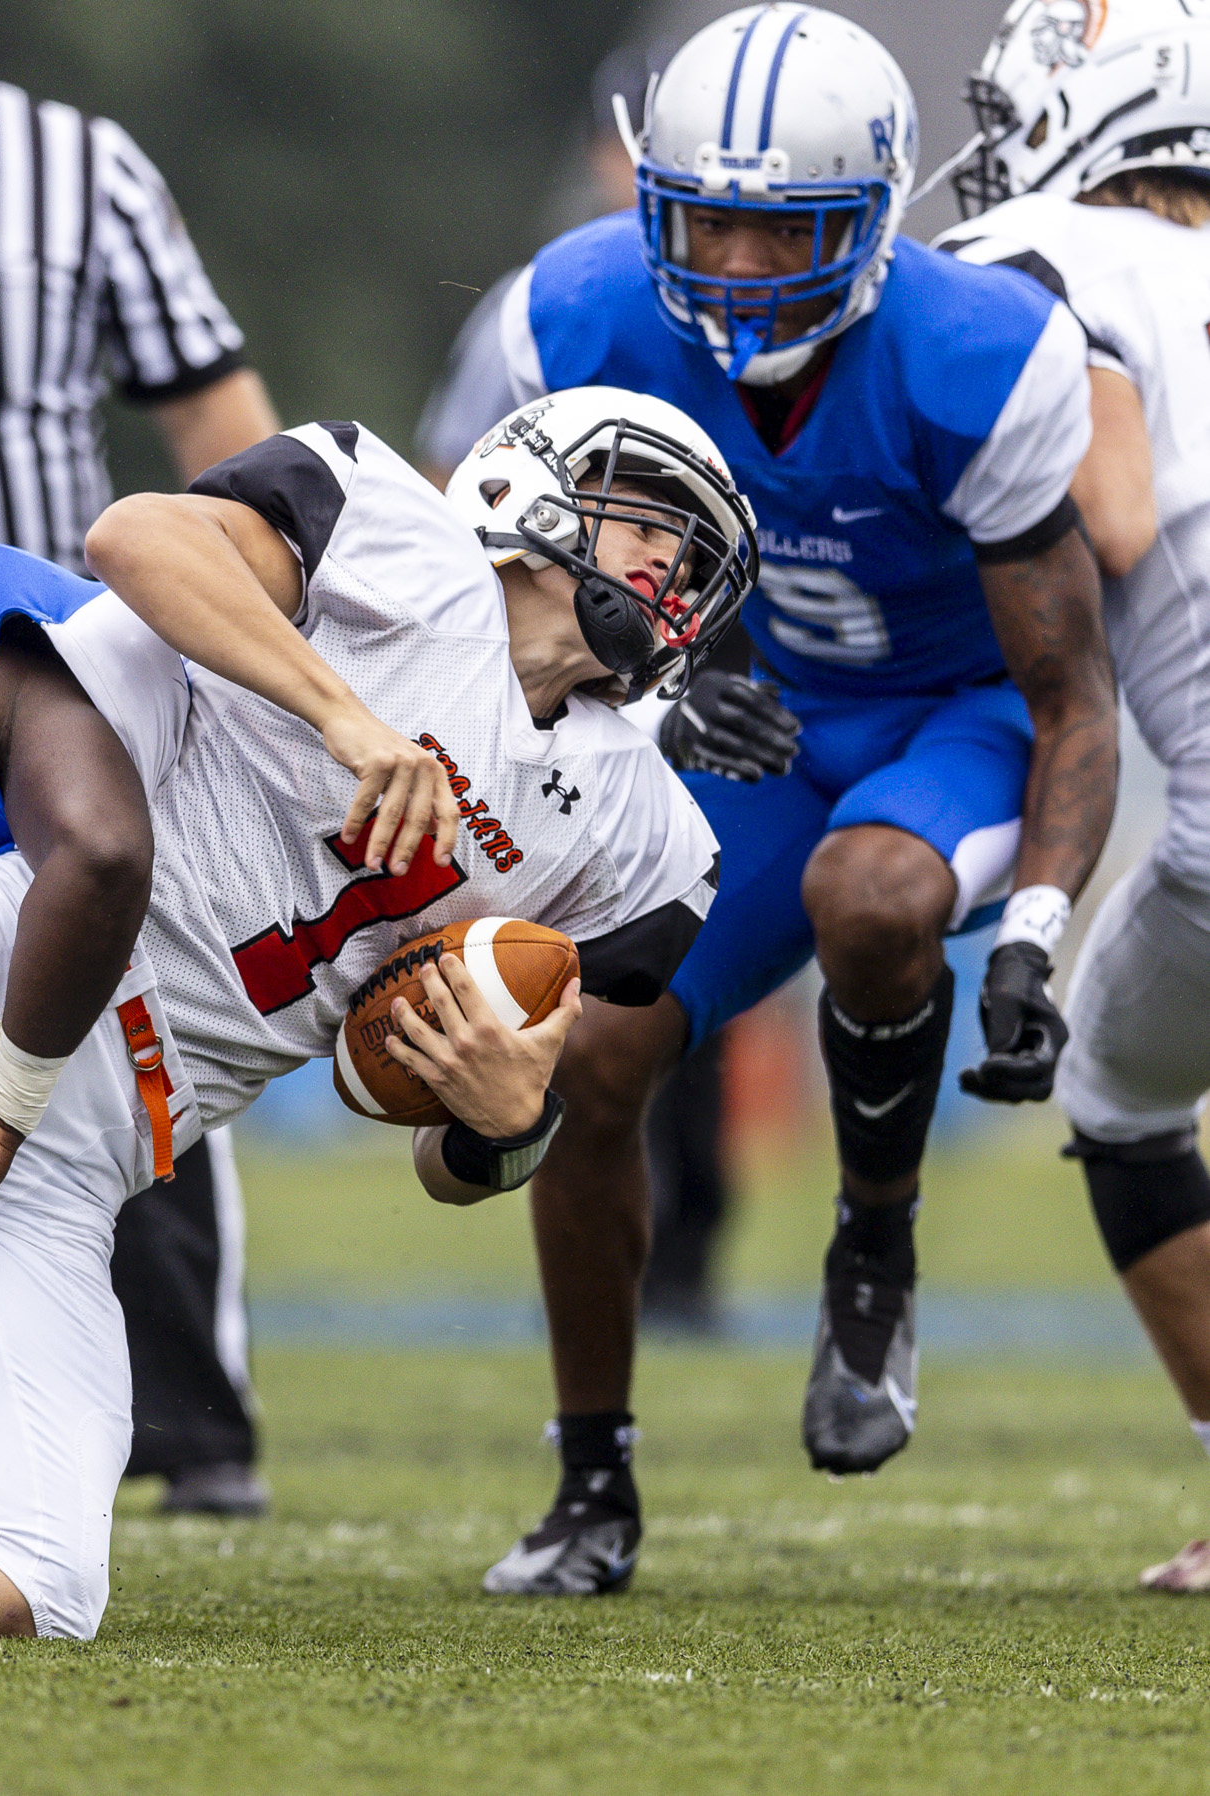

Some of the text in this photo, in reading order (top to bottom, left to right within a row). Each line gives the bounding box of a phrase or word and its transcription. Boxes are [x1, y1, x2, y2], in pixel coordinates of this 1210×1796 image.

[740, 527, 854, 564] OLLERS
[752, 560, 891, 669] 9
[359, 998, 436, 1051] Wilon
